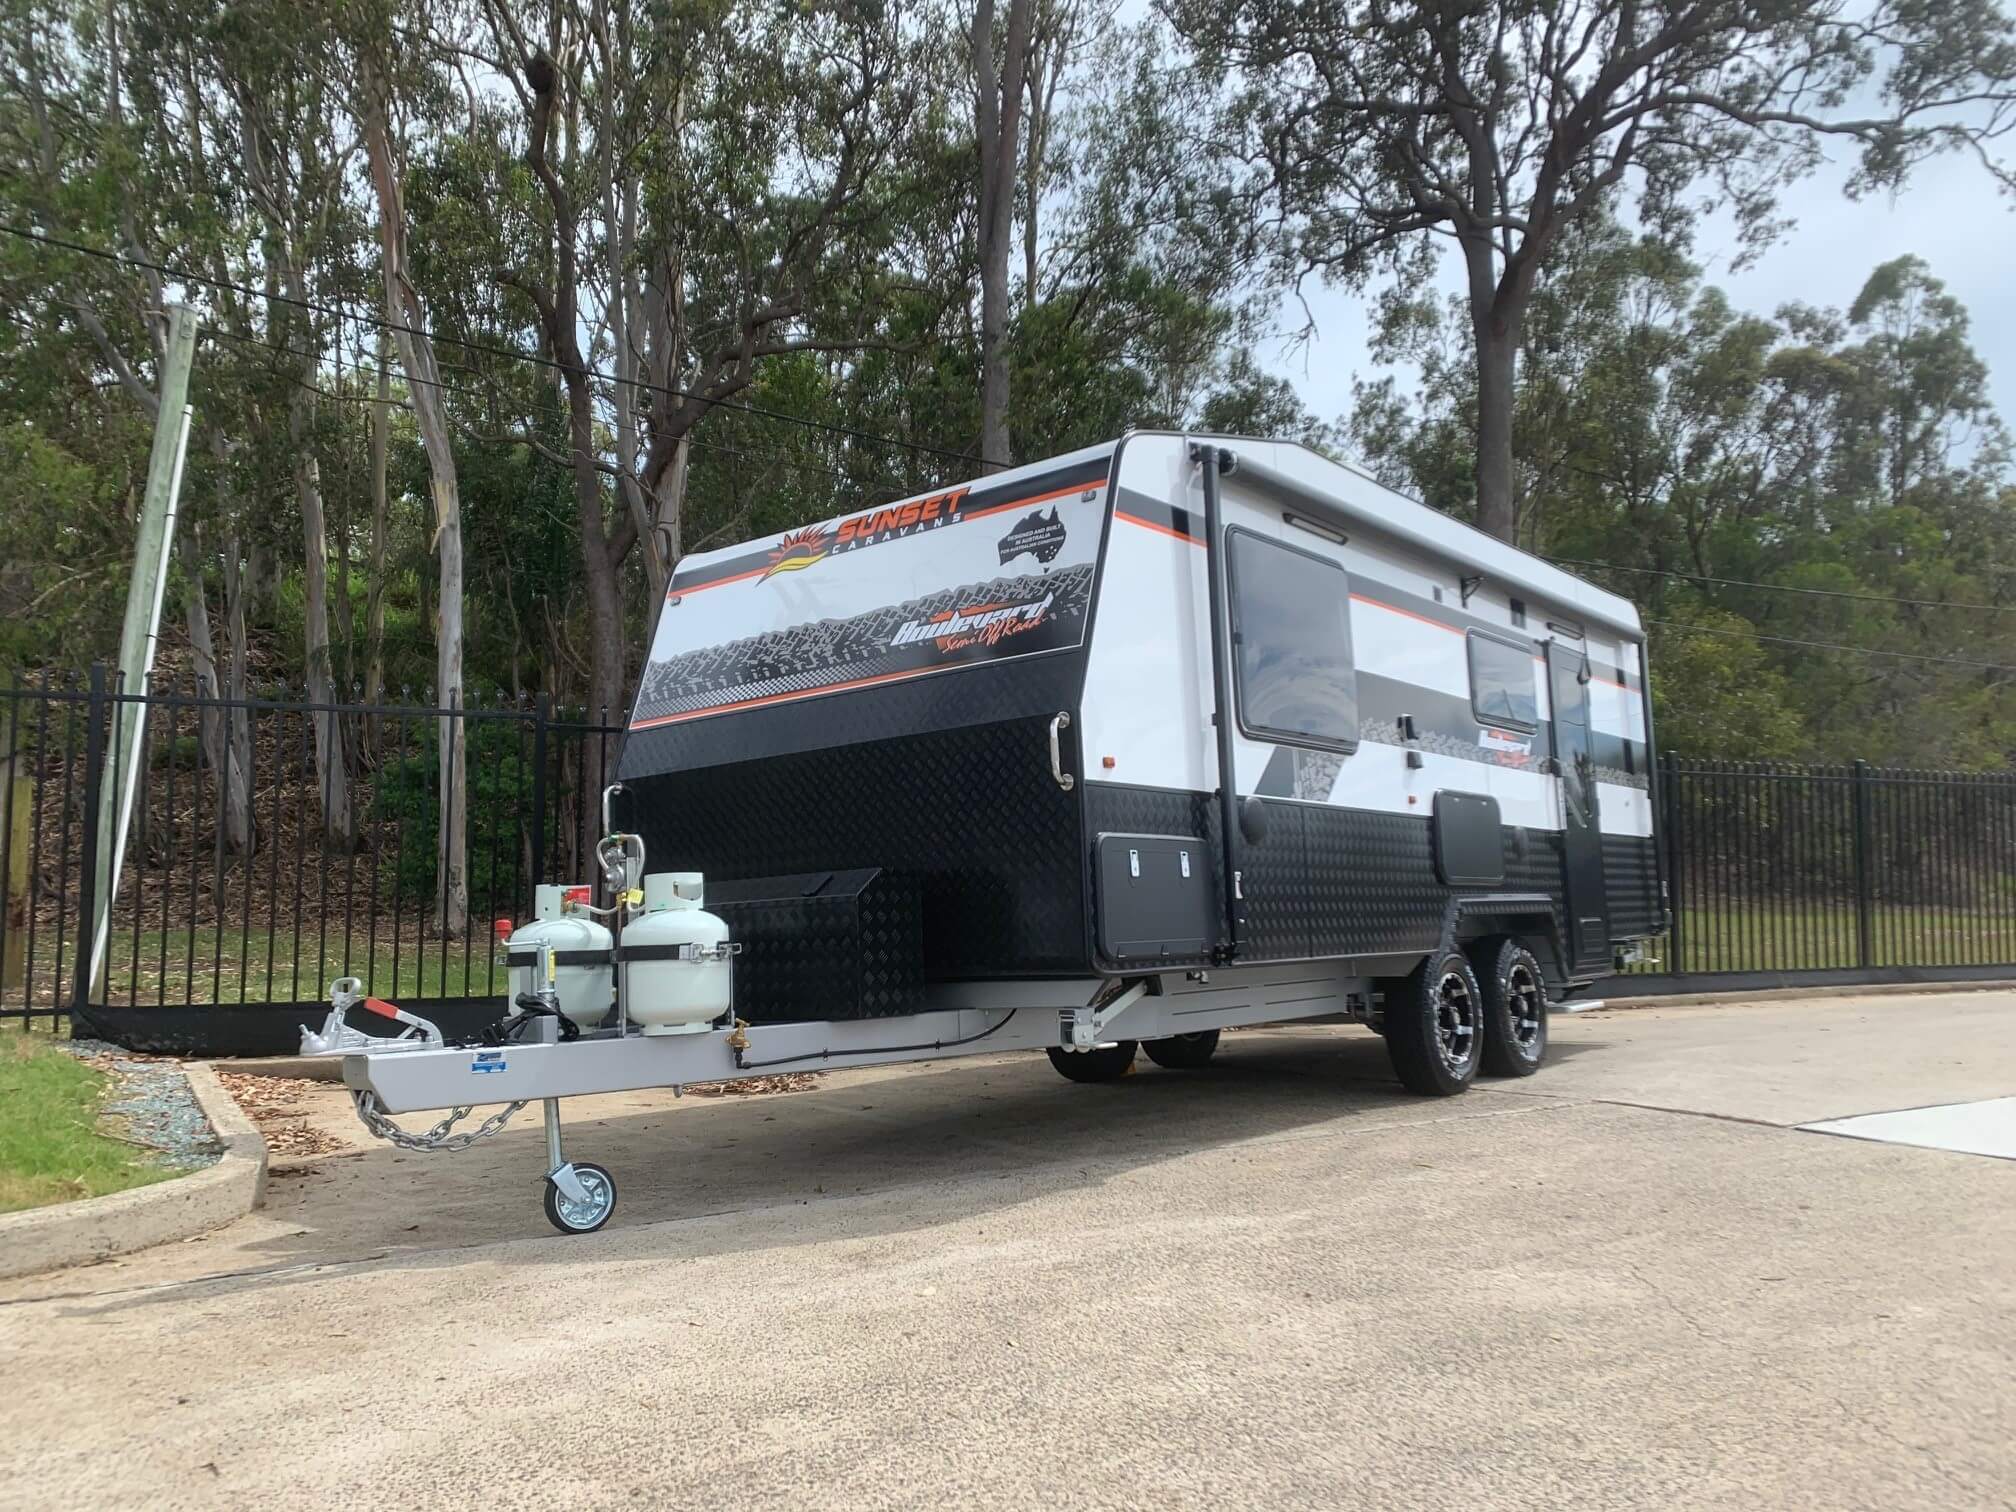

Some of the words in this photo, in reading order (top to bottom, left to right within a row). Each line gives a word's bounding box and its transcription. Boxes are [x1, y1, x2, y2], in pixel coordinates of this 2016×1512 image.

[832, 512, 961, 554] CARAVANS
[836, 487, 971, 543] SUNSET
[890, 591, 1054, 646] Boulevard
[942, 630, 978, 654] Semi
[978, 618, 1005, 646] Off
[1002, 616, 1043, 636] Road
